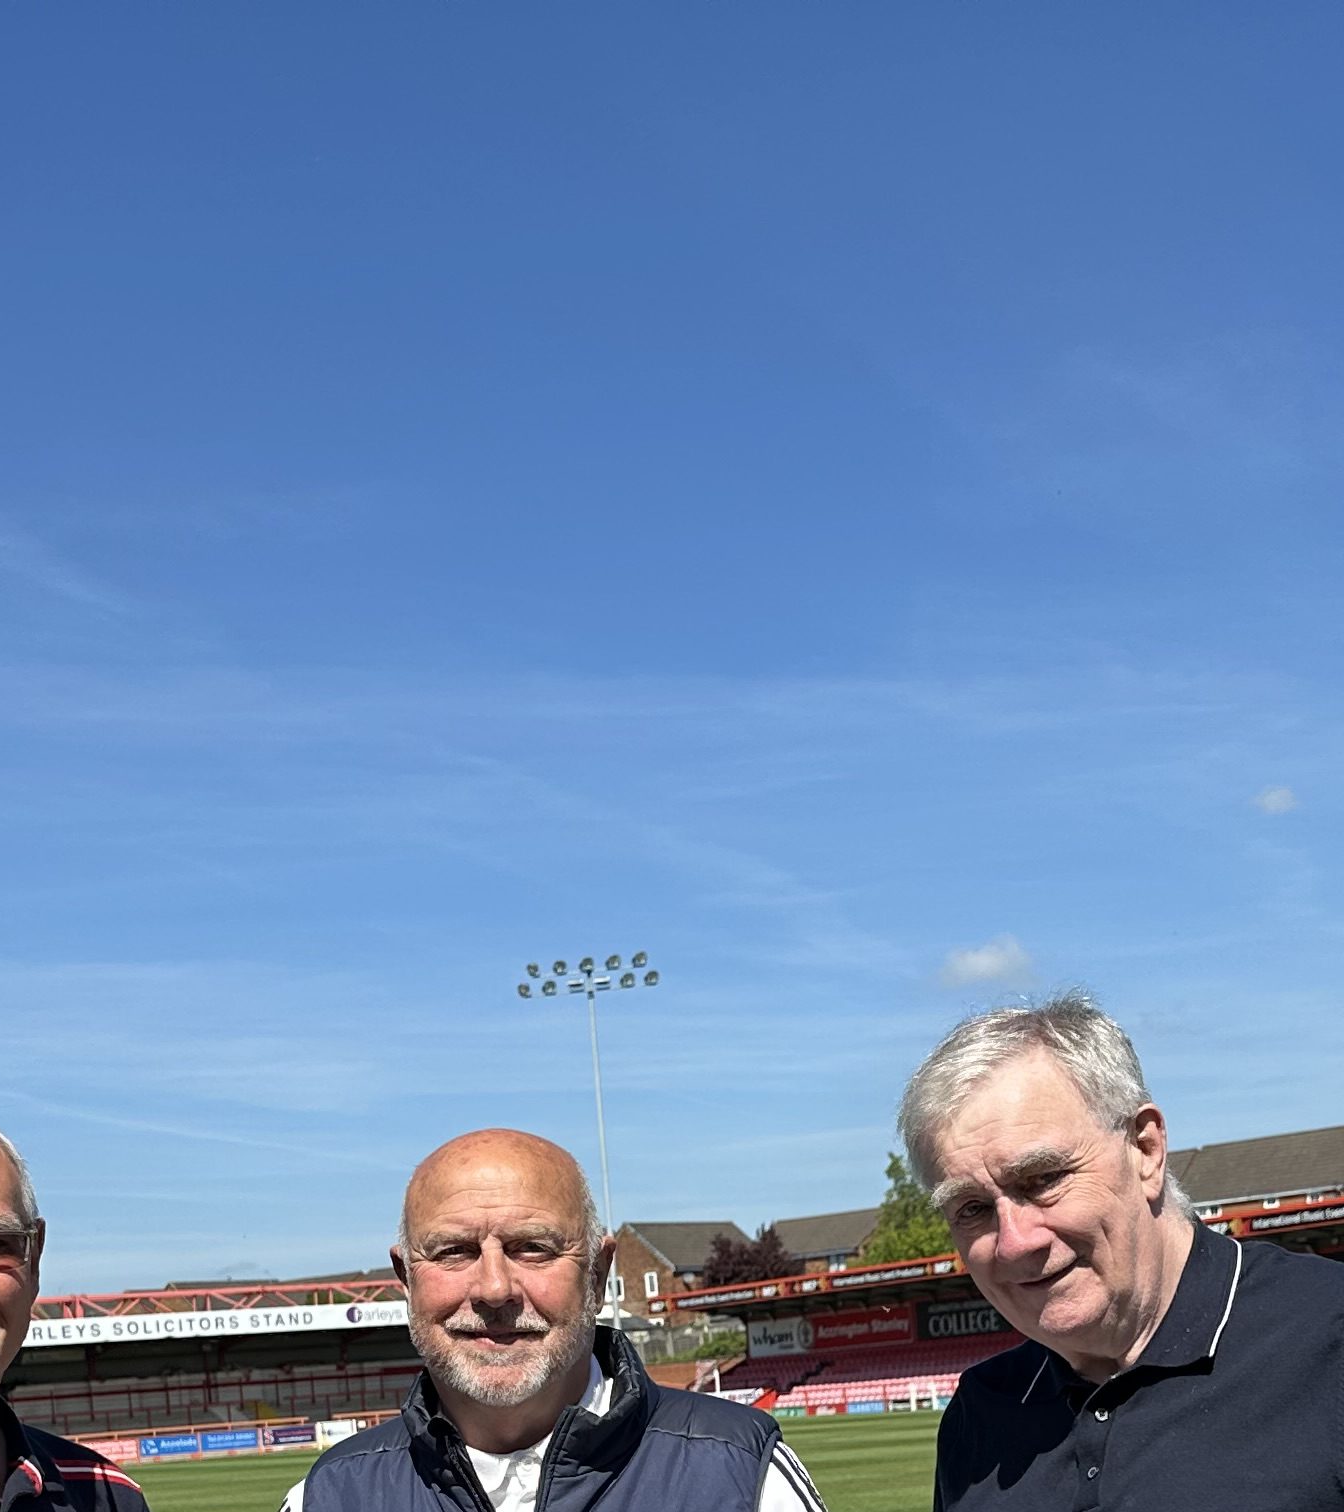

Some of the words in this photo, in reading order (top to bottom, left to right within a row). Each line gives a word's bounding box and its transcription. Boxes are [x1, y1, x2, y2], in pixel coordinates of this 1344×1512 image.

[32, 1322, 101, 1341] RLEYS
[113, 1315, 240, 1336] SOLICITORS
[249, 1310, 314, 1328] STAND
[928, 1308, 1000, 1337] COLLEGE
